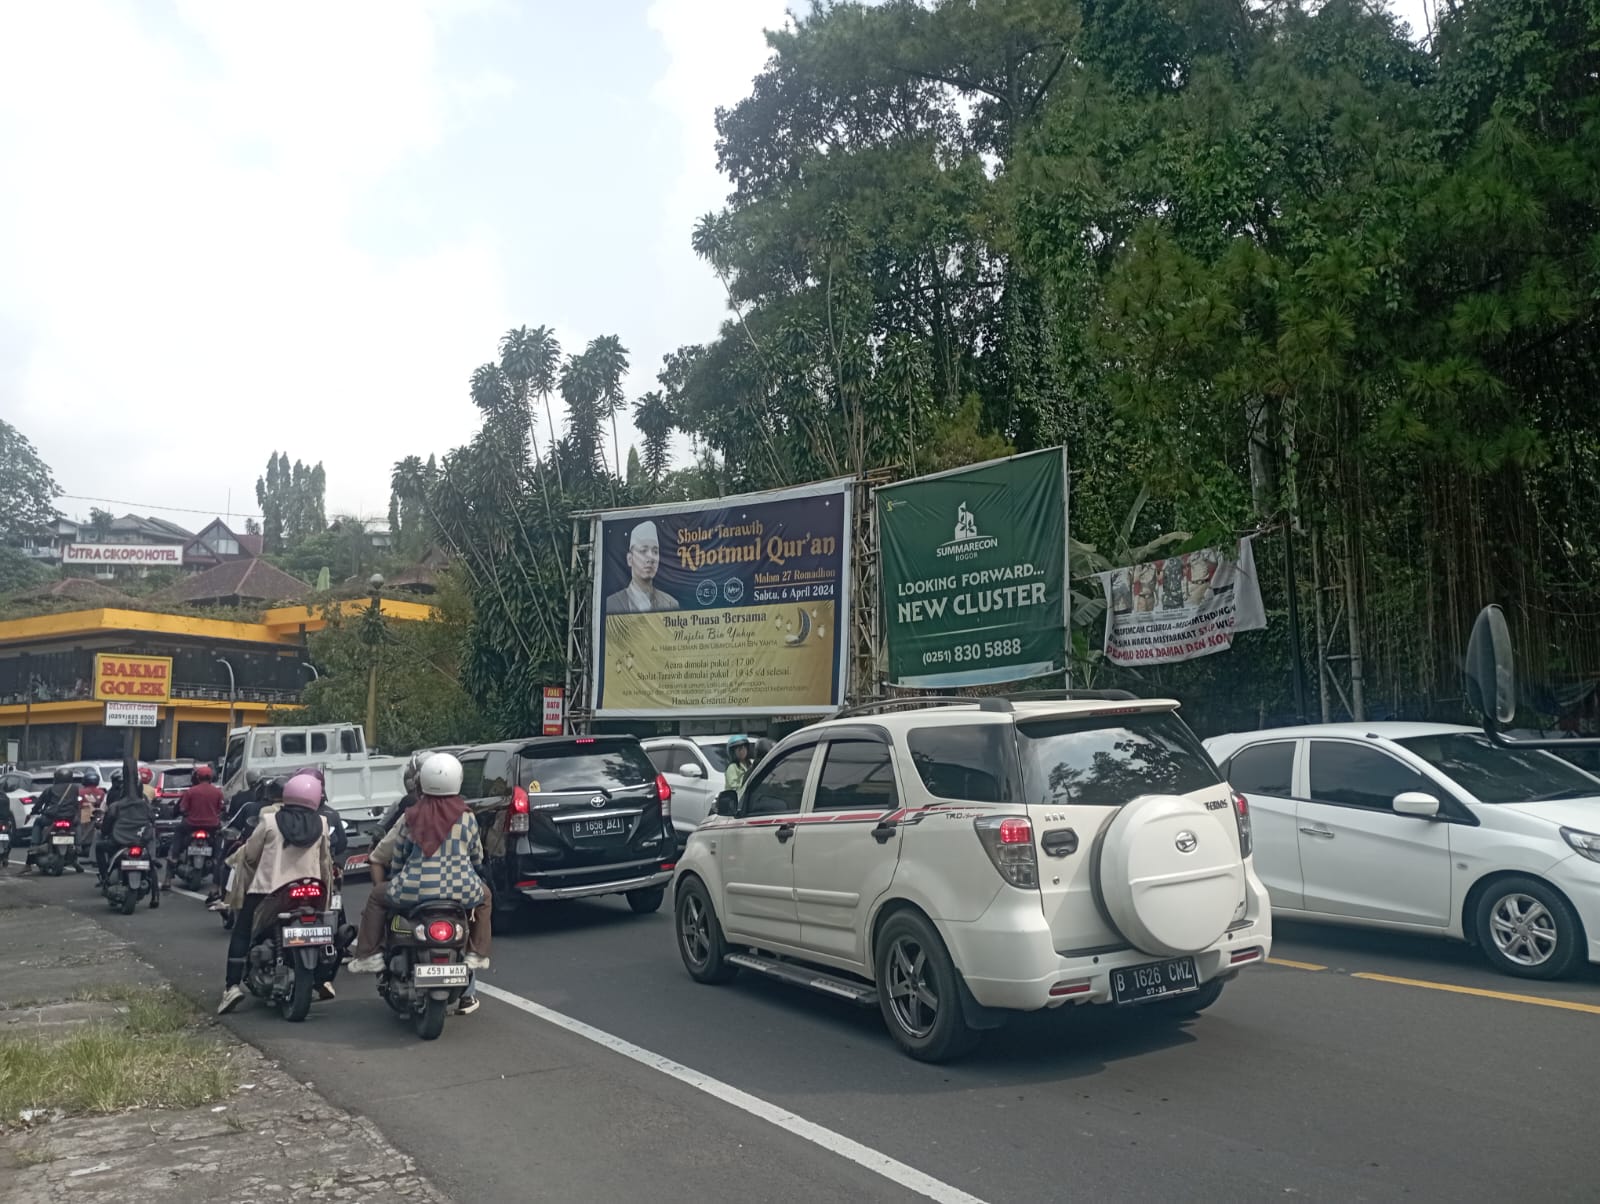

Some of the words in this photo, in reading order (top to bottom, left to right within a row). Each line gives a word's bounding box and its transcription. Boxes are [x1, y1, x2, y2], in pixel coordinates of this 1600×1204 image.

[677, 527, 712, 545] Sholat
[714, 520, 763, 541] Tarawih
[68, 547, 102, 560] CITRA
[677, 540, 760, 570] Khotmul
[767, 532, 836, 560] Qur'an
[936, 537, 998, 557] SUMMARECON
[955, 552, 978, 562] BOGOR
[754, 573, 780, 585] Malam
[782, 571, 792, 582] 27
[898, 575, 957, 597] LOOKING
[962, 563, 1045, 587] FORWARD...
[754, 589, 780, 601] Sabtu,
[782, 589, 787, 598] 6
[789, 585, 811, 600] April
[813, 583, 835, 597] 2024
[898, 596, 948, 624] NEW
[953, 581, 1047, 616] CLUSTER
[664, 615, 689, 629] Buka
[690, 613, 720, 627] Puasa
[722, 611, 767, 625] Bersama
[922, 650, 952, 666] (0251)
[954, 645, 981, 662] 830
[984, 638, 1022, 659] 5888
[1136, 648, 1154, 660] 2024
[1155, 644, 1185, 658] DAMAI
[101, 662, 168, 679] BAKMI
[664, 661, 684, 670] Acara
[684, 660, 709, 669] dimulai
[710, 658, 730, 670] pukul
[100, 680, 166, 697] GOLEK
[728, 696, 750, 706] Bogor
[576, 822, 581, 833] B
[1116, 973, 1126, 992] B
[1133, 966, 1162, 990] 1626
[1168, 960, 1193, 982] CMZ
